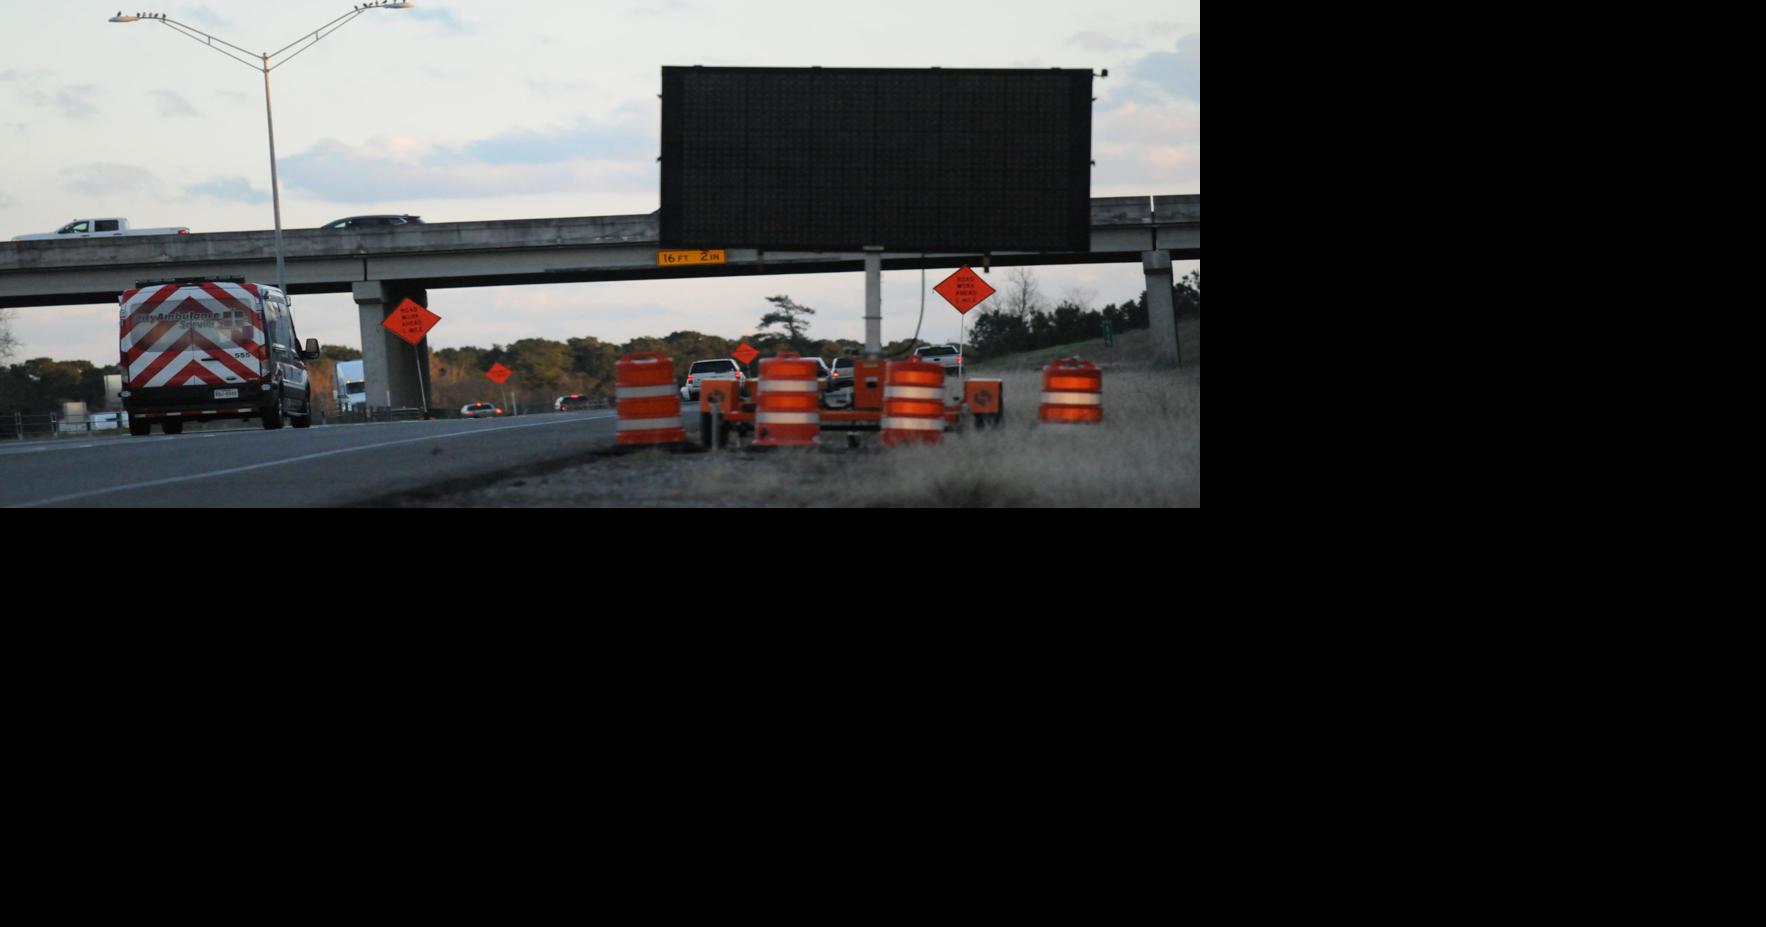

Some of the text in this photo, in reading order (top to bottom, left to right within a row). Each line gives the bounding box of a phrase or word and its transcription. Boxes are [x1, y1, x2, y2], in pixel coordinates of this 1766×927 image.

[663, 251, 720, 263] 16 FT 2 IN
